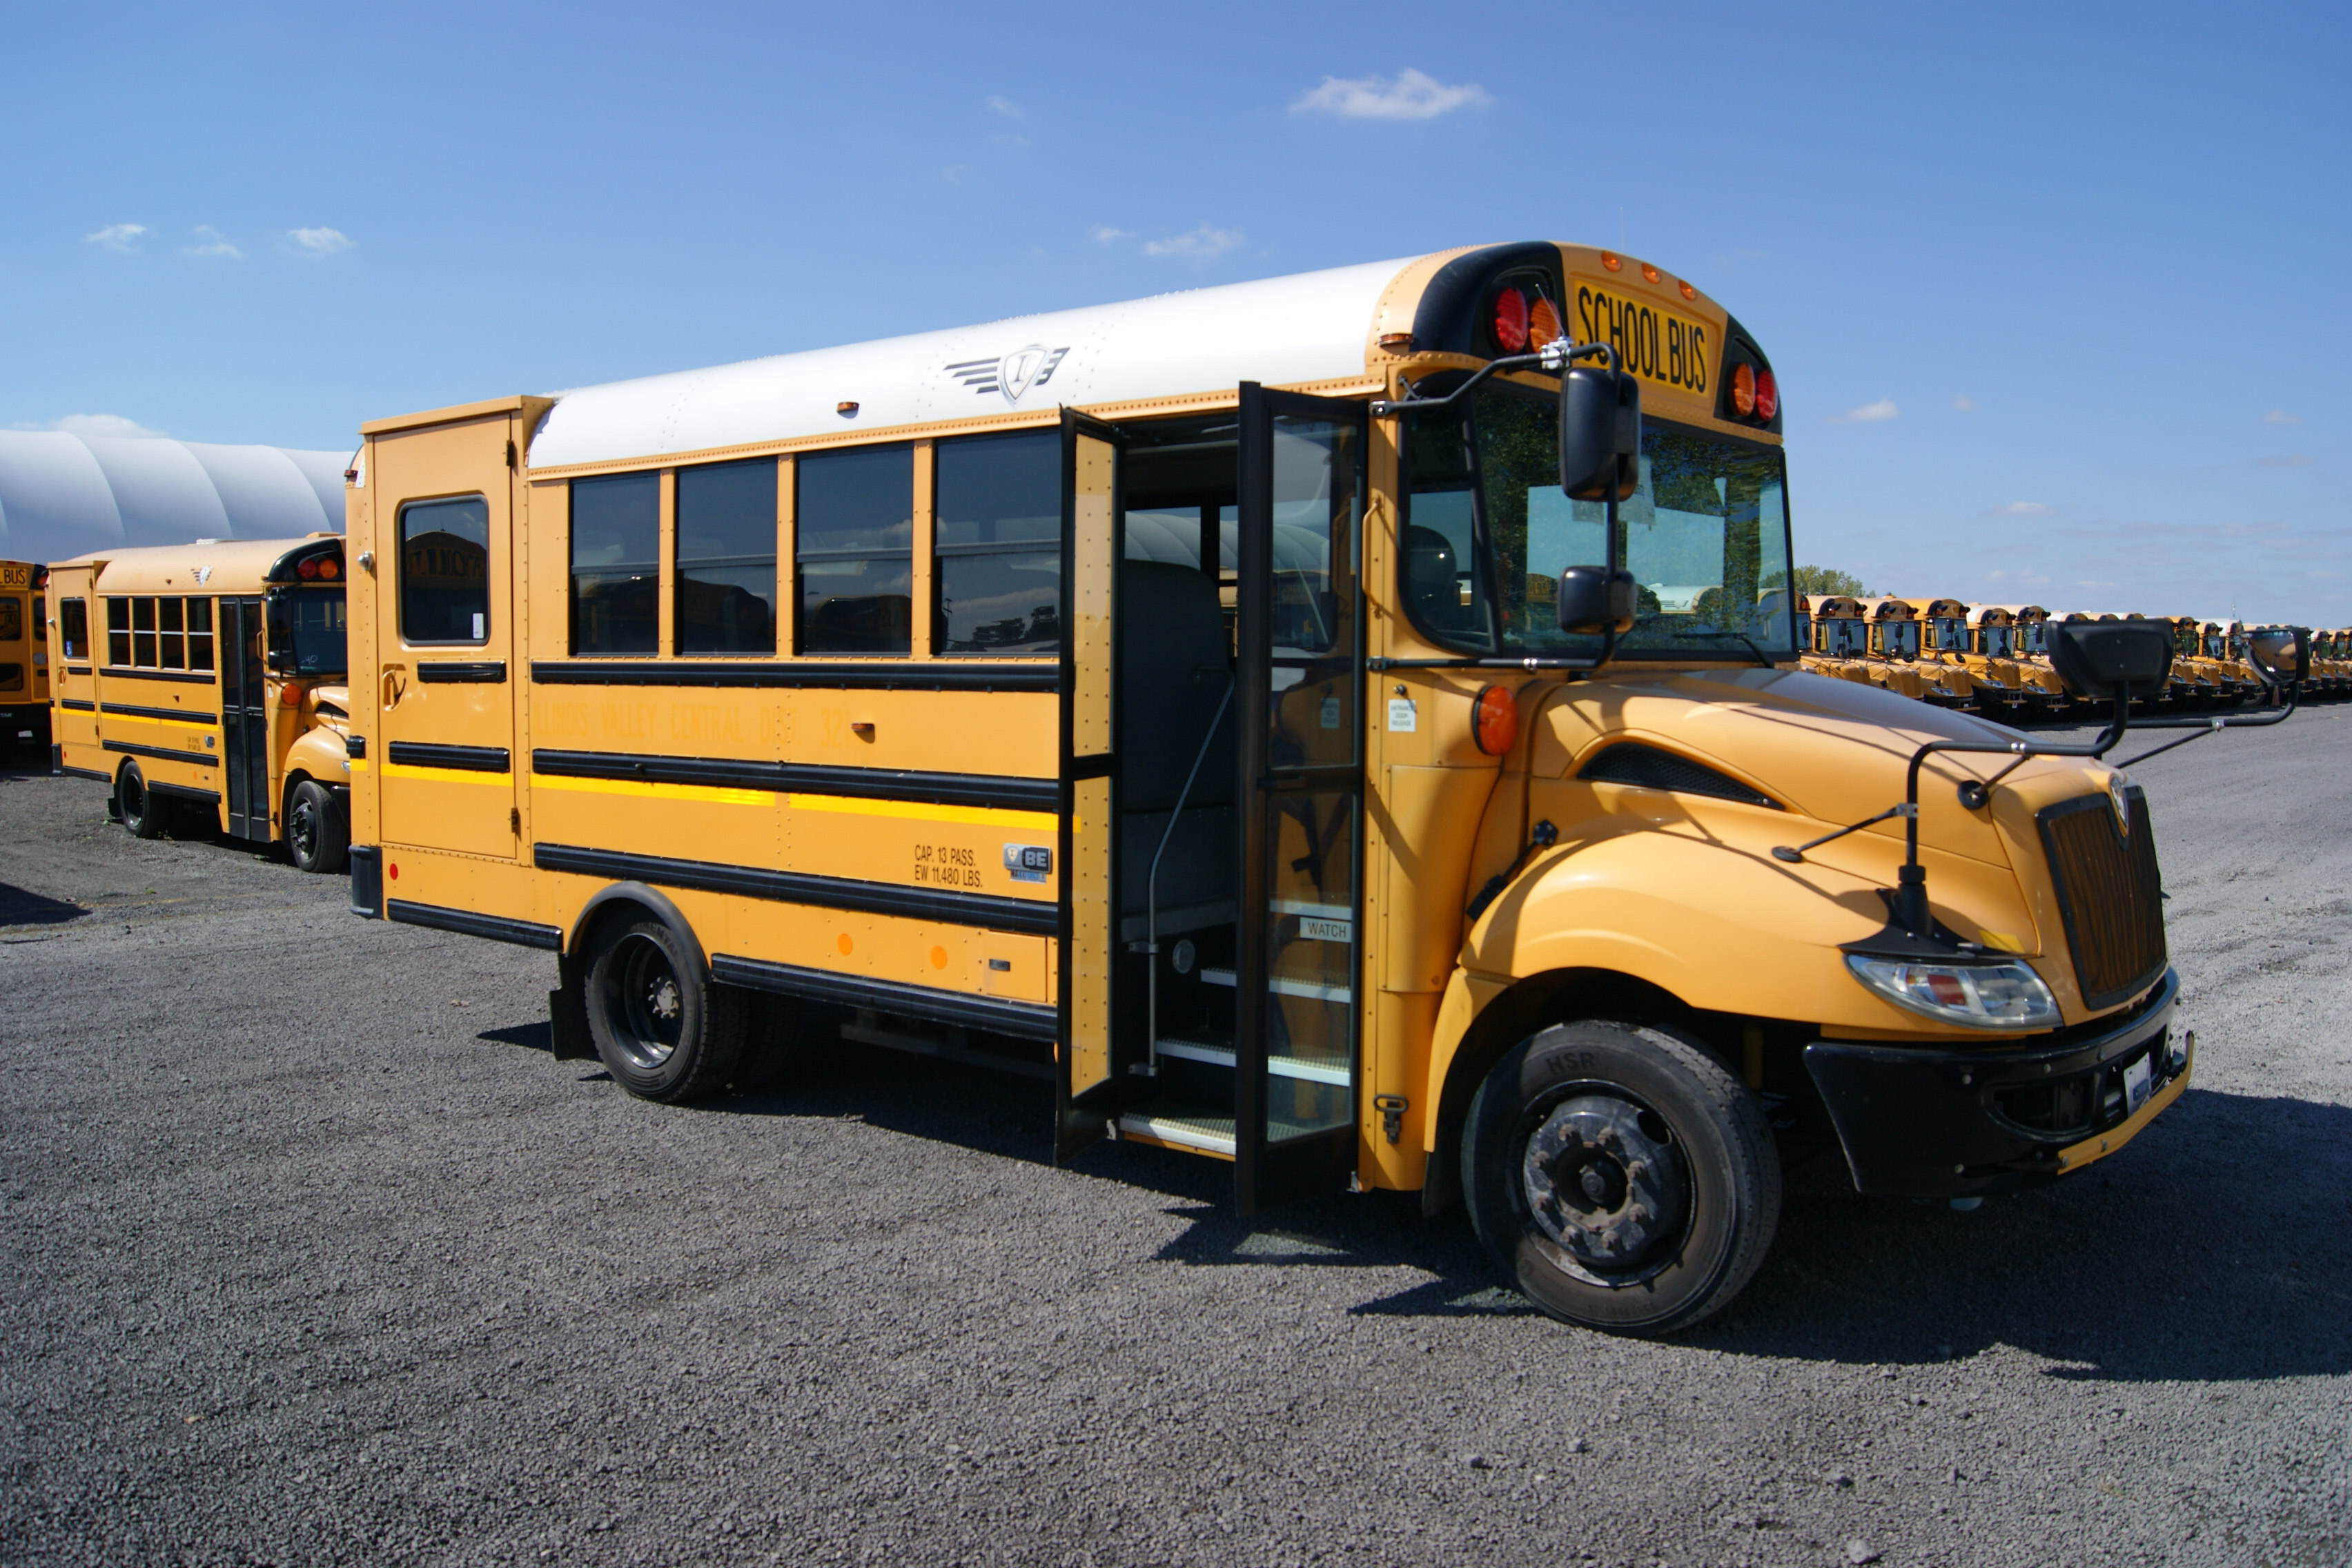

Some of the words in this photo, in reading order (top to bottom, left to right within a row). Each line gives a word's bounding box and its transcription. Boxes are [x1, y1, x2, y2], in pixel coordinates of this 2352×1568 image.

[1579, 286, 1666, 380] SCHOOL
[1668, 317, 1706, 393] BUS
[4, 569, 26, 584] BUS
[600, 703, 657, 738] VALLEY
[669, 703, 745, 743] CENTRAL
[819, 707, 850, 748] 321
[914, 845, 934, 862] CAP.
[938, 847, 946, 863] 13
[950, 848, 976, 866] PASS.
[1025, 851, 1047, 868] BE
[915, 864, 928, 881] EW
[932, 866, 959, 885] 11,480
[963, 870, 983, 888] LBS.
[1308, 921, 1346, 938] WATCH
